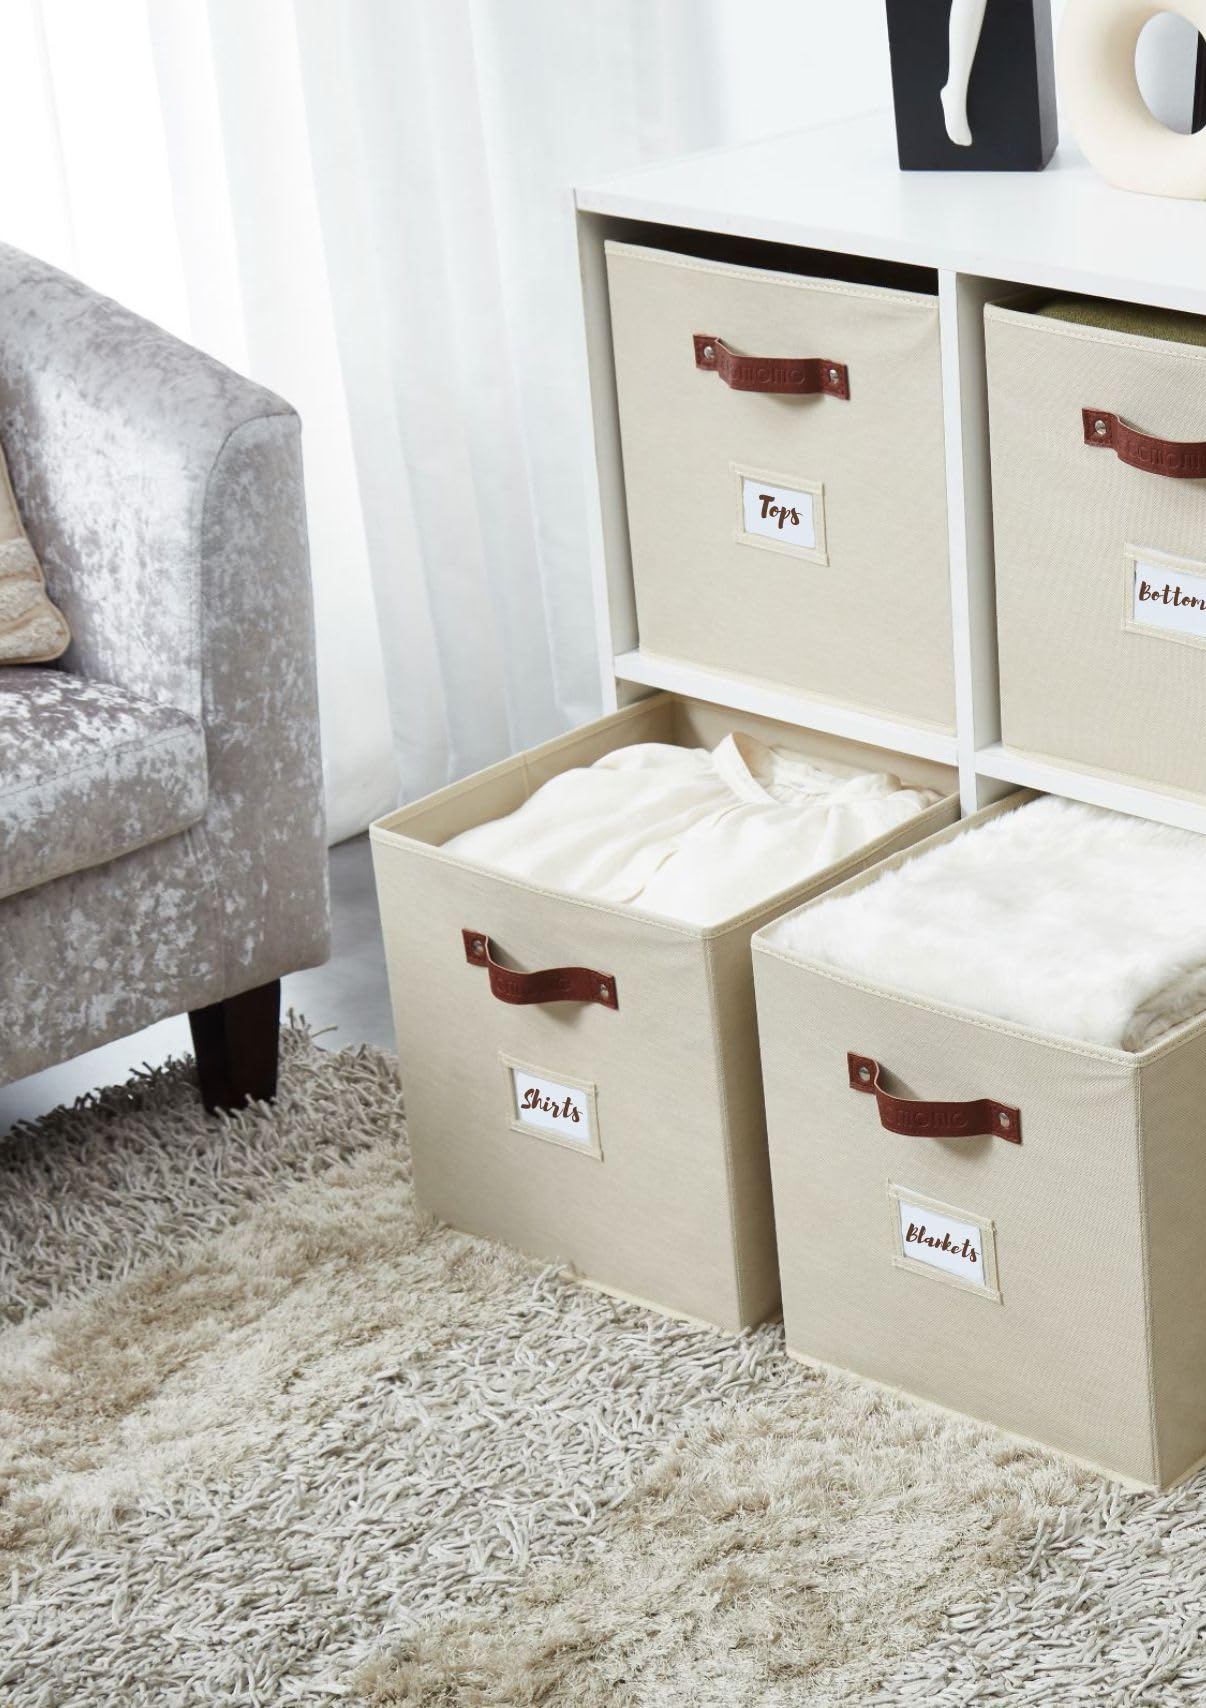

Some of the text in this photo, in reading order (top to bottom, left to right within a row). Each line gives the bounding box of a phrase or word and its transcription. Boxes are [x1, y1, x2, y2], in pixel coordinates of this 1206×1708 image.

[759, 494, 803, 529] Tops
[521, 1088, 583, 1122] Shirts
[906, 1223, 980, 1262] Blankets
